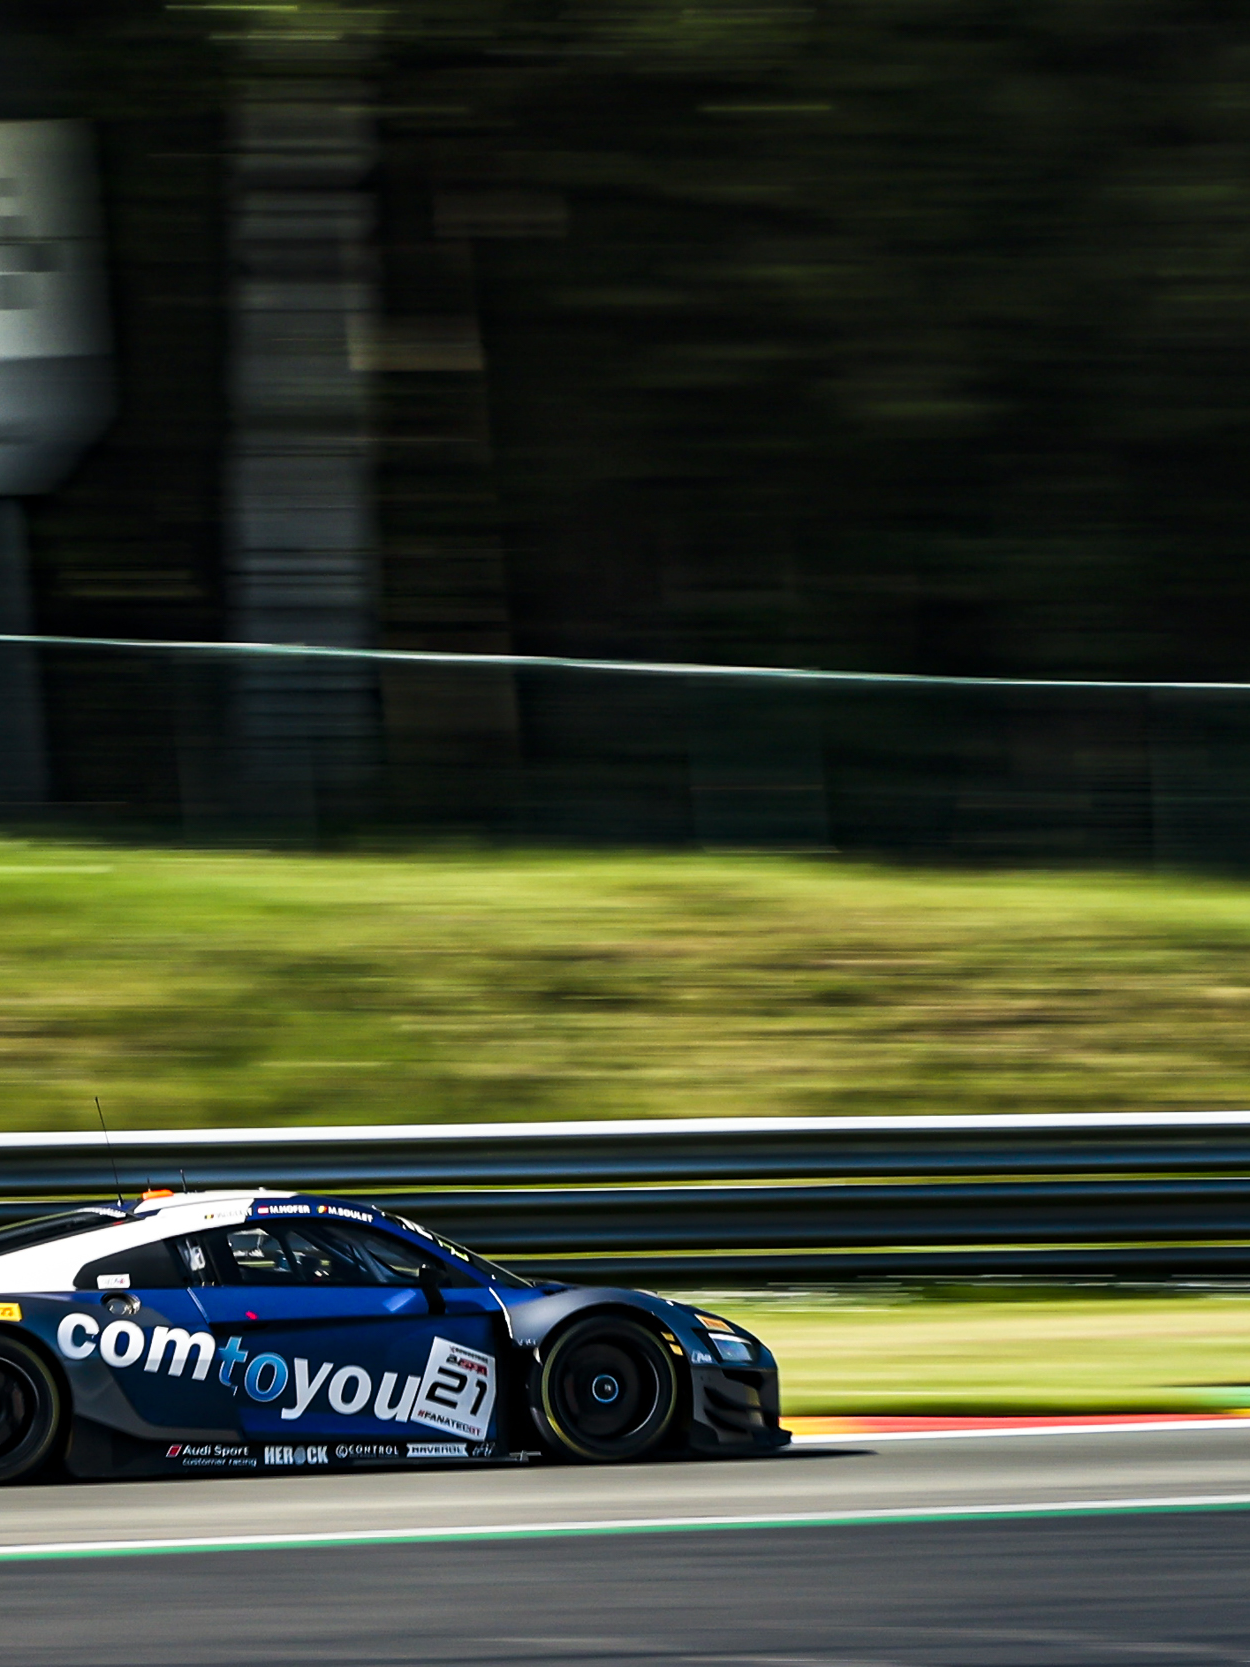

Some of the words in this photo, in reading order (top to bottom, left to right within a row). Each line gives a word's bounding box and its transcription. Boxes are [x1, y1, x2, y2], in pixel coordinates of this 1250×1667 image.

[56, 1311, 422, 1423] comtoyou
[425, 1366, 488, 1417] 21
[182, 1444, 212, 1456] Audi
[214, 1444, 250, 1458] Sport
